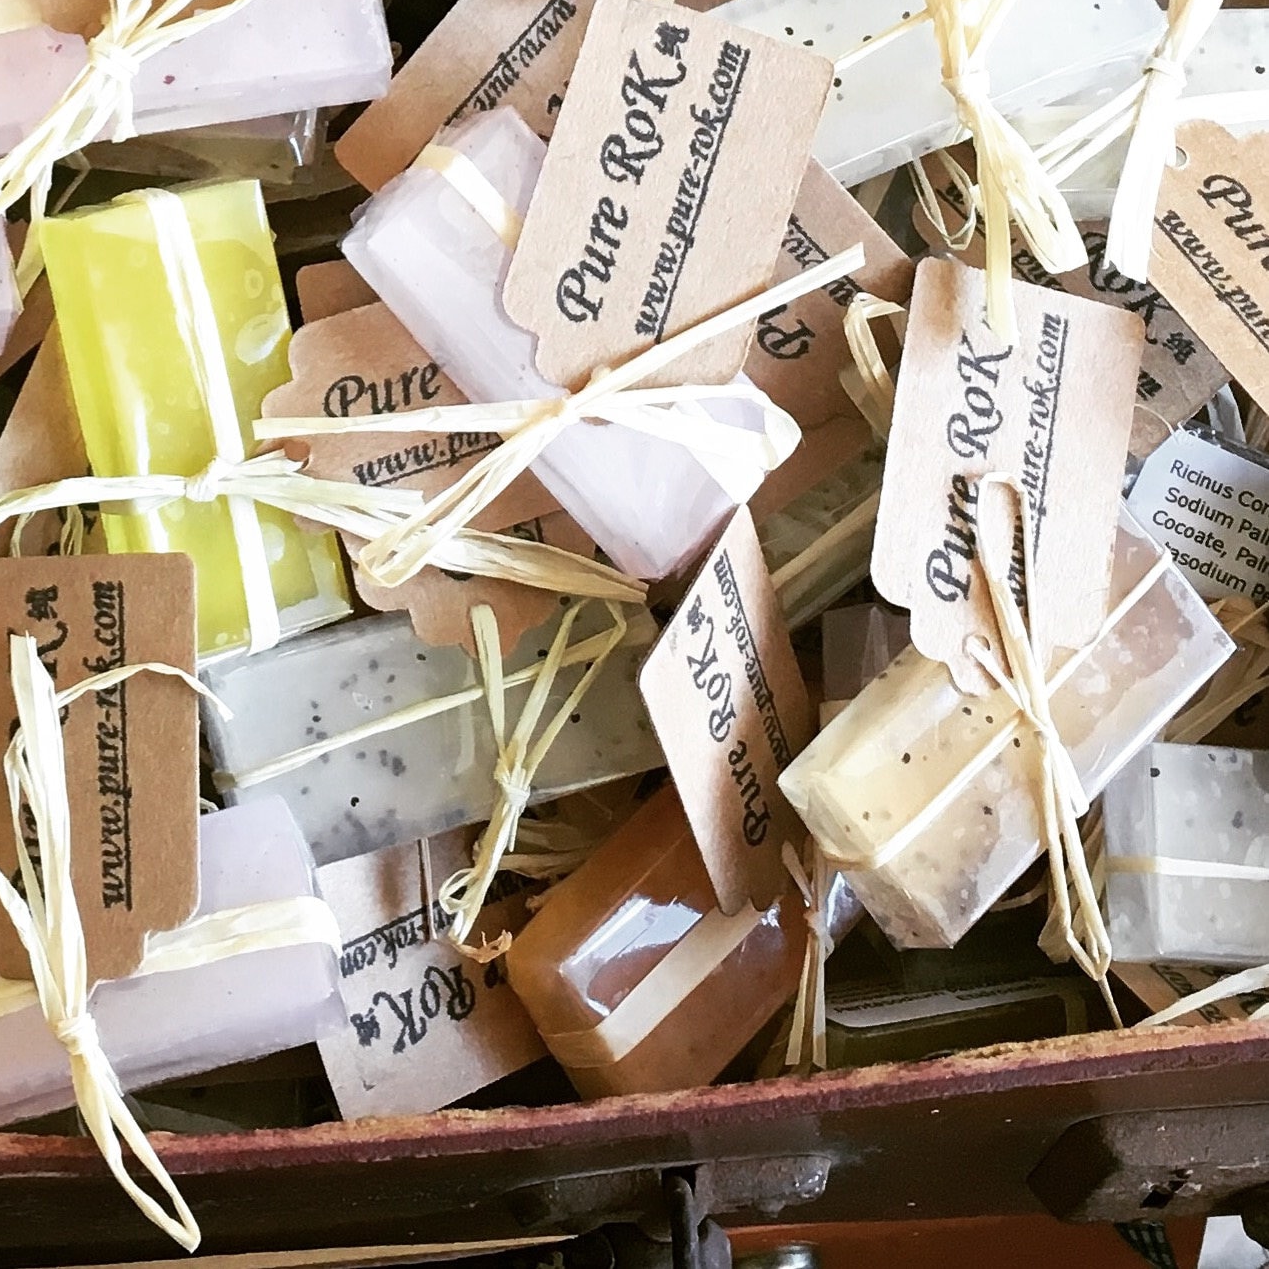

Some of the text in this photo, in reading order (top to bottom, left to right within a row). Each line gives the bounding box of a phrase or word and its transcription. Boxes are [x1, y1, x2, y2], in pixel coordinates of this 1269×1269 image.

[556, 197, 629, 325] Pure
[600, 49, 687, 186] RoK
[635, 40, 751, 344] www.pure-rok.com
[322, 362, 441, 417] Pure
[947, 327, 1013, 460] RoK
[926, 474, 980, 602] Pure
[1153, 510, 1227, 559] Cocoate,
[1165, 487, 1234, 529] Sodium
[1170, 459, 1234, 500] Ricinus
[84, 580, 132, 912] www.pure-rok.com
[687, 616, 771, 847] Pure RoK
[393, 964, 475, 1054] RoK
